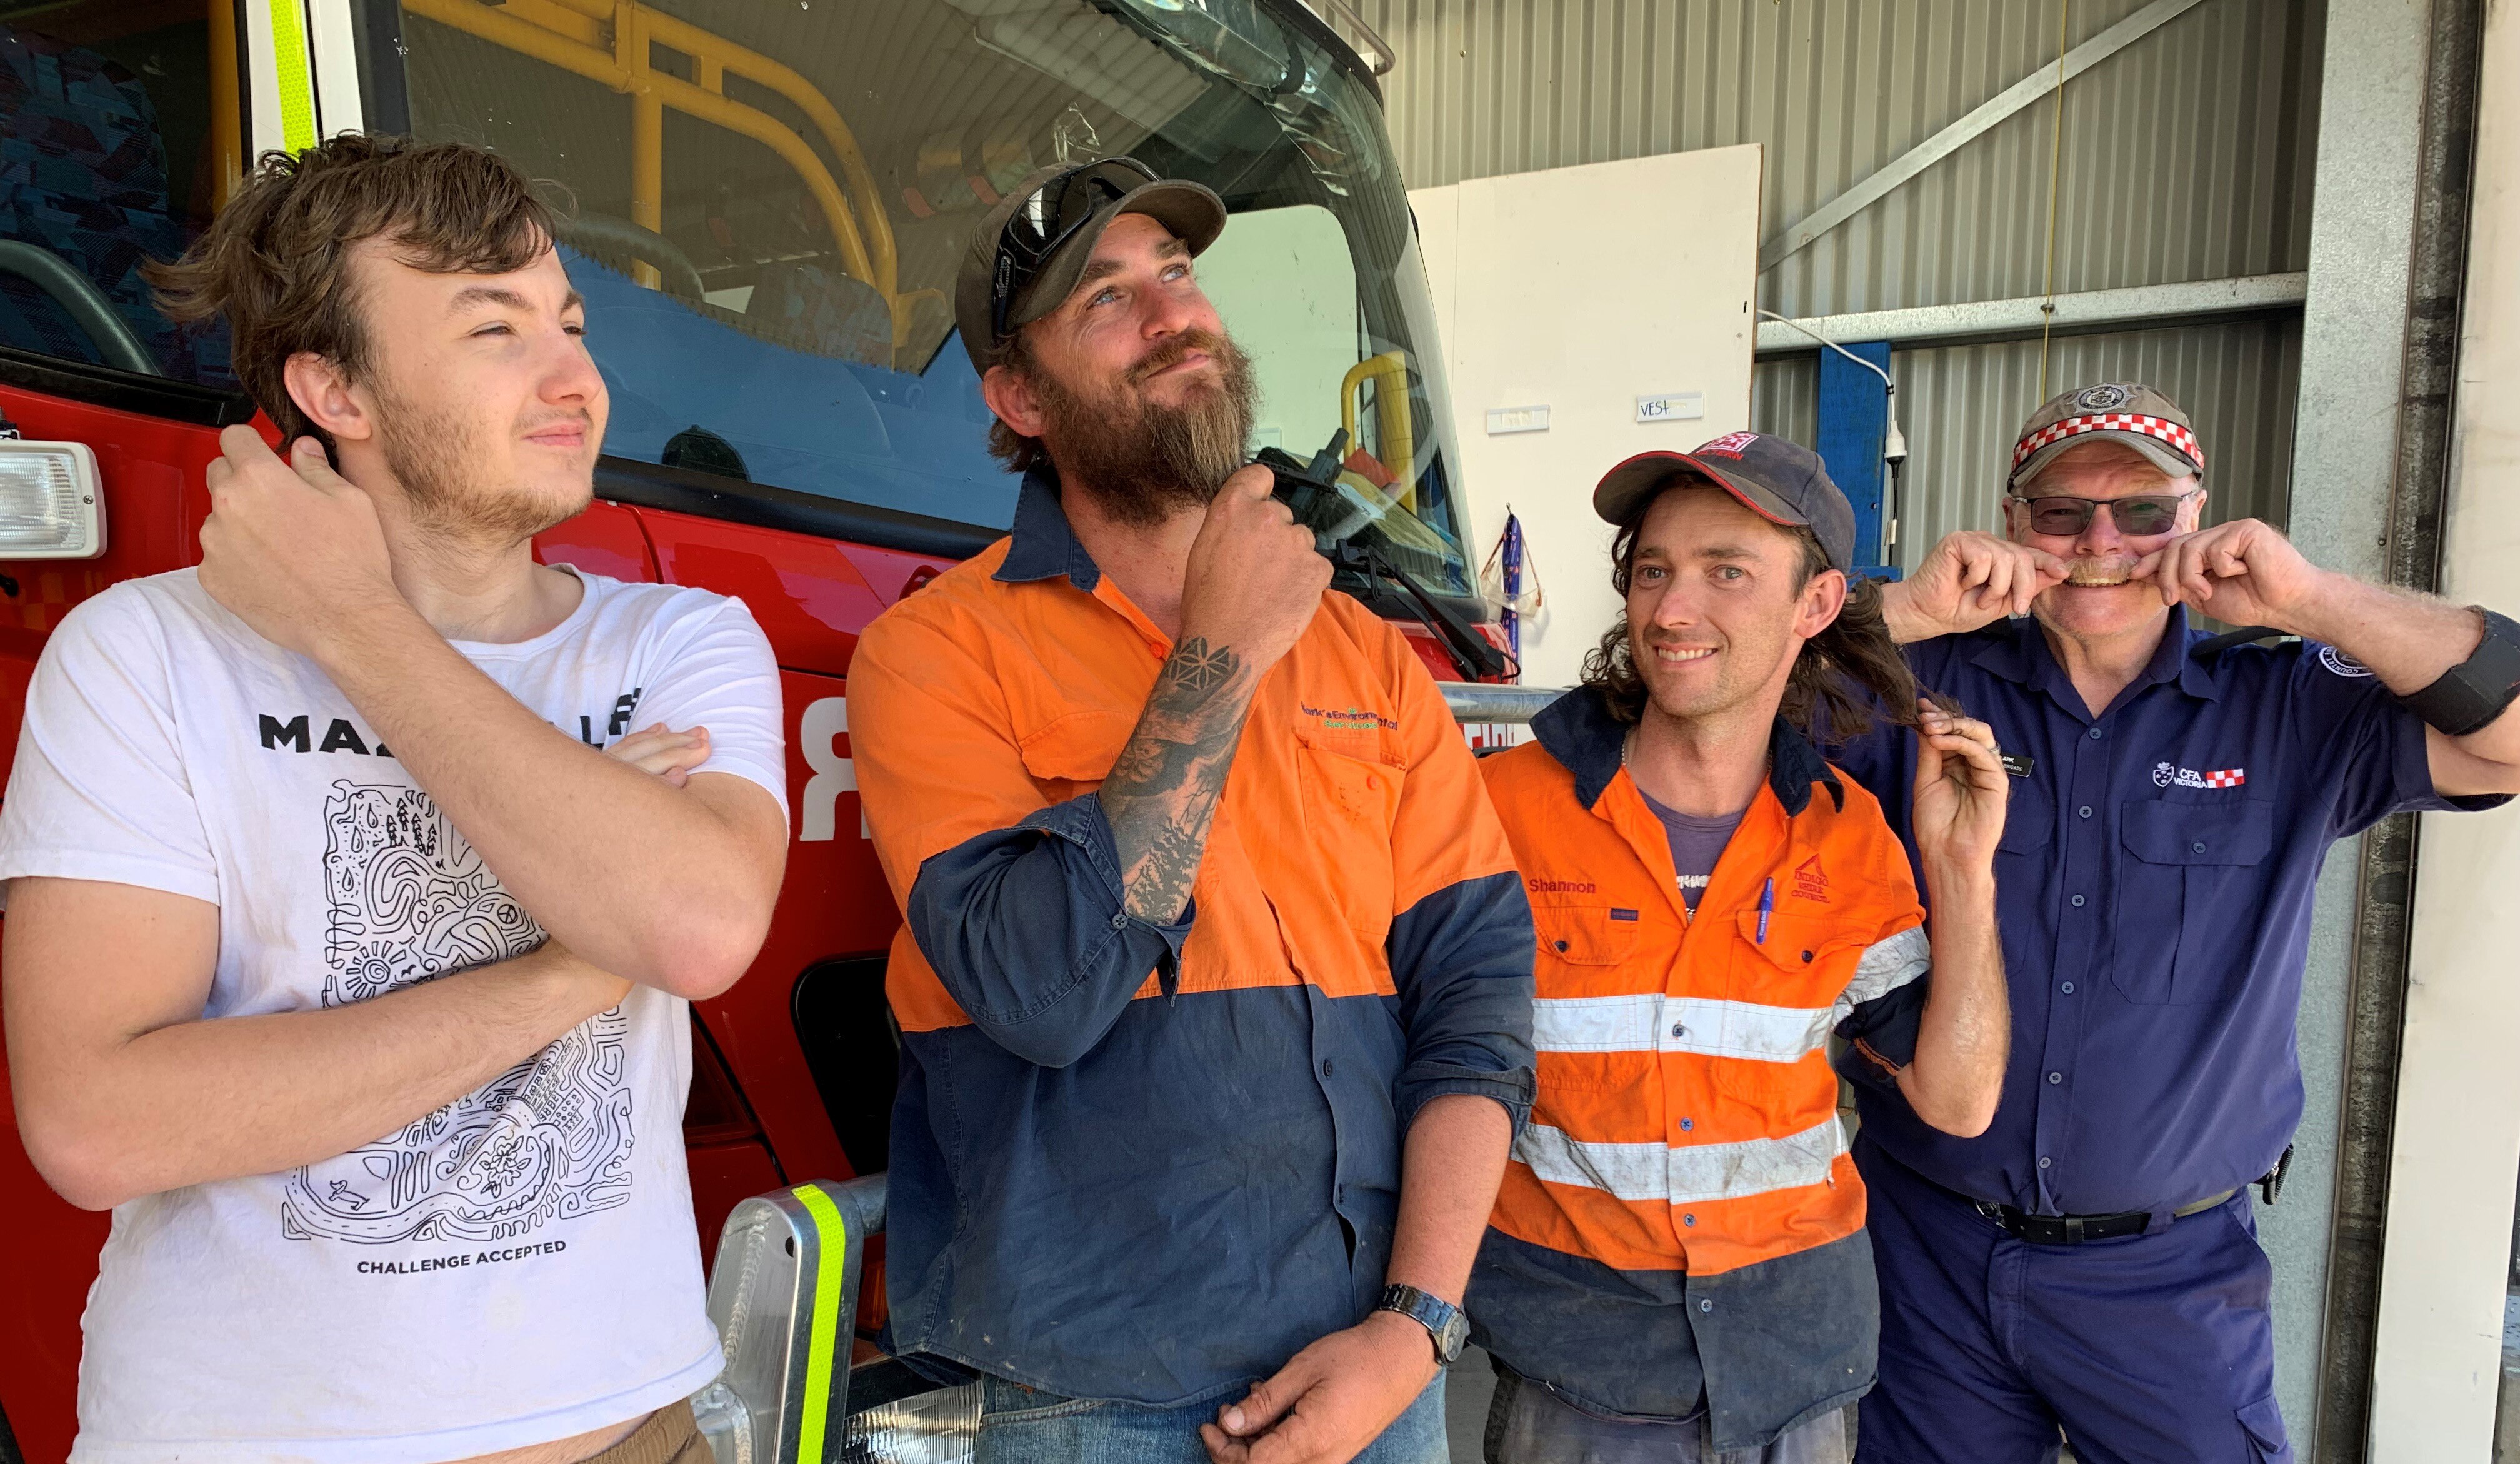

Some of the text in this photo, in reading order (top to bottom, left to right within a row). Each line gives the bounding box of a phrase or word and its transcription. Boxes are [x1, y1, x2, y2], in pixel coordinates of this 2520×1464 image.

[2325, 657, 2359, 674] COUNTRY
[2180, 768, 2201, 781] CFA
[2174, 777, 2208, 788] VICTORIA
[1529, 878, 1595, 894] Shannon
[1794, 871, 1829, 886] INDIGO
[358, 1240, 566, 1275] CHALLENGE ACCEPTED
